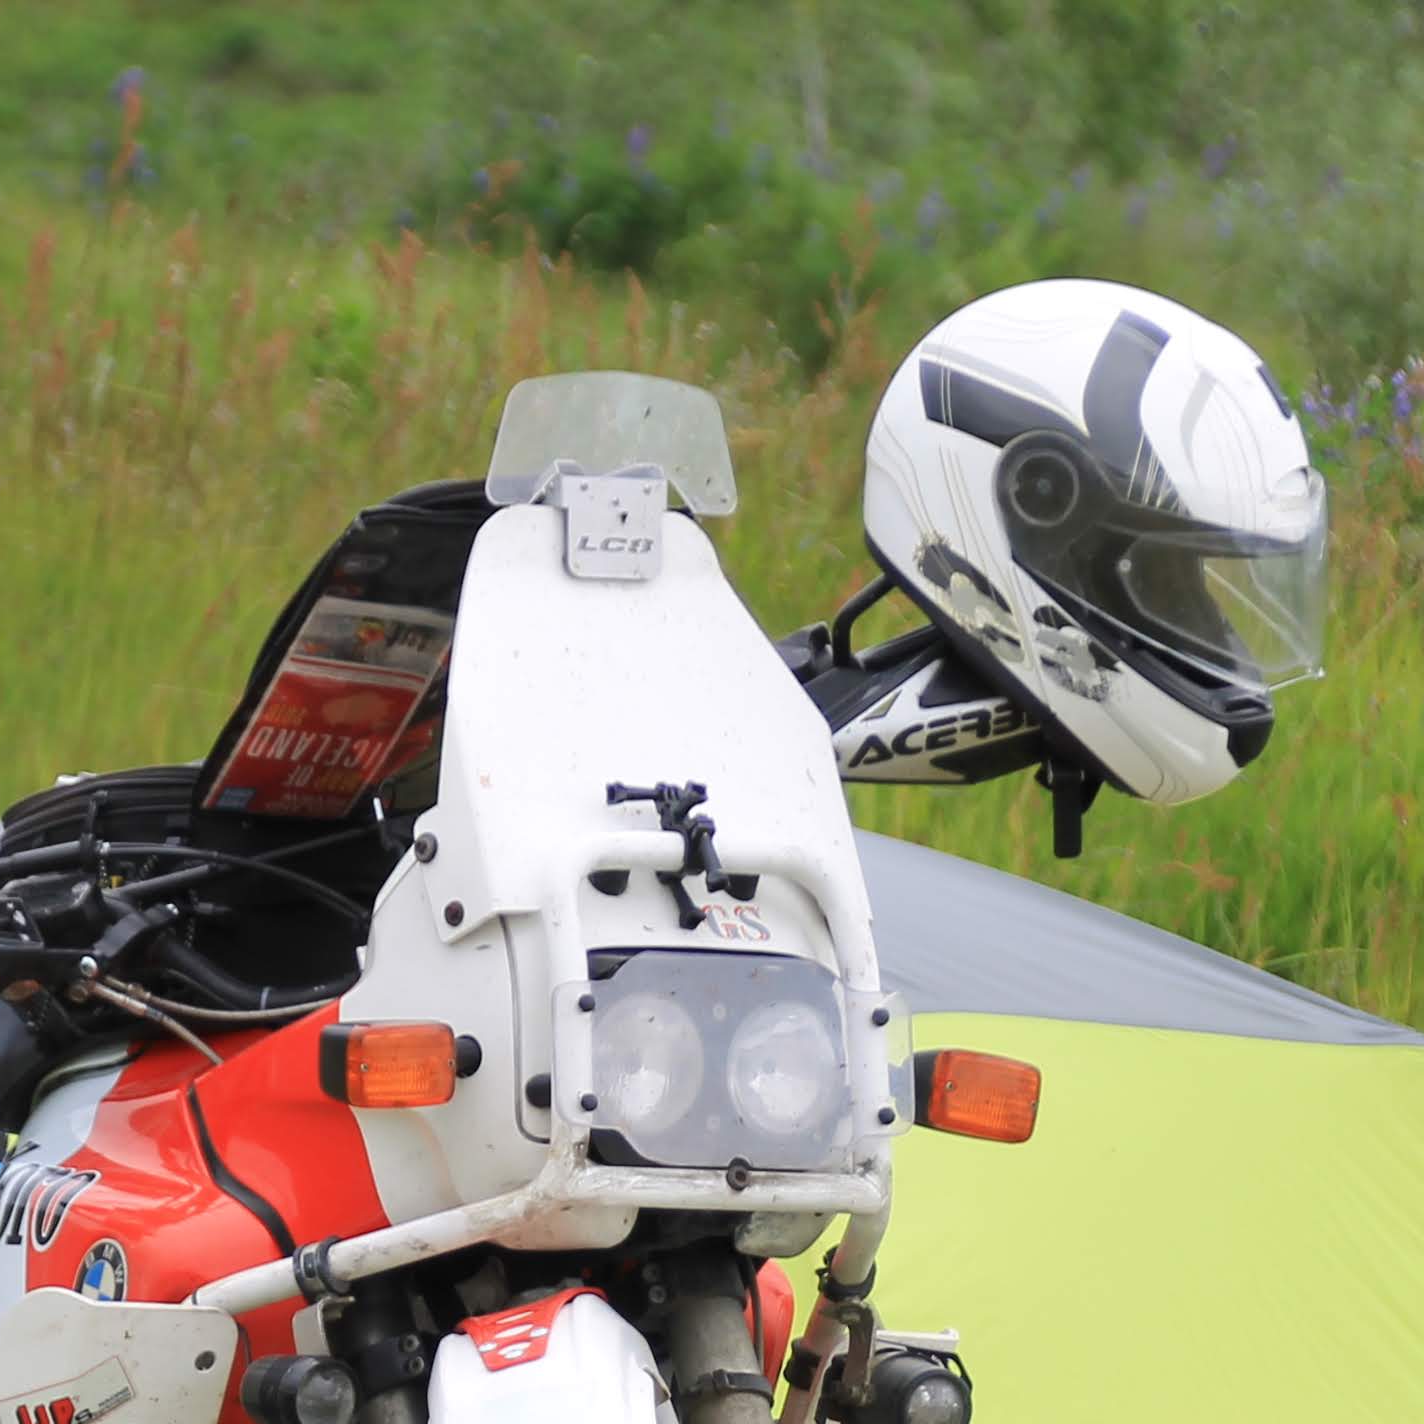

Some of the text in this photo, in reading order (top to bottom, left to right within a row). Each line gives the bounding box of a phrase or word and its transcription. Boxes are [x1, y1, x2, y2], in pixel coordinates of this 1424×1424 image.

[246, 726, 384, 769] ICELAND
[700, 904, 771, 941] GS
[84, 1244, 125, 1284] BMW
